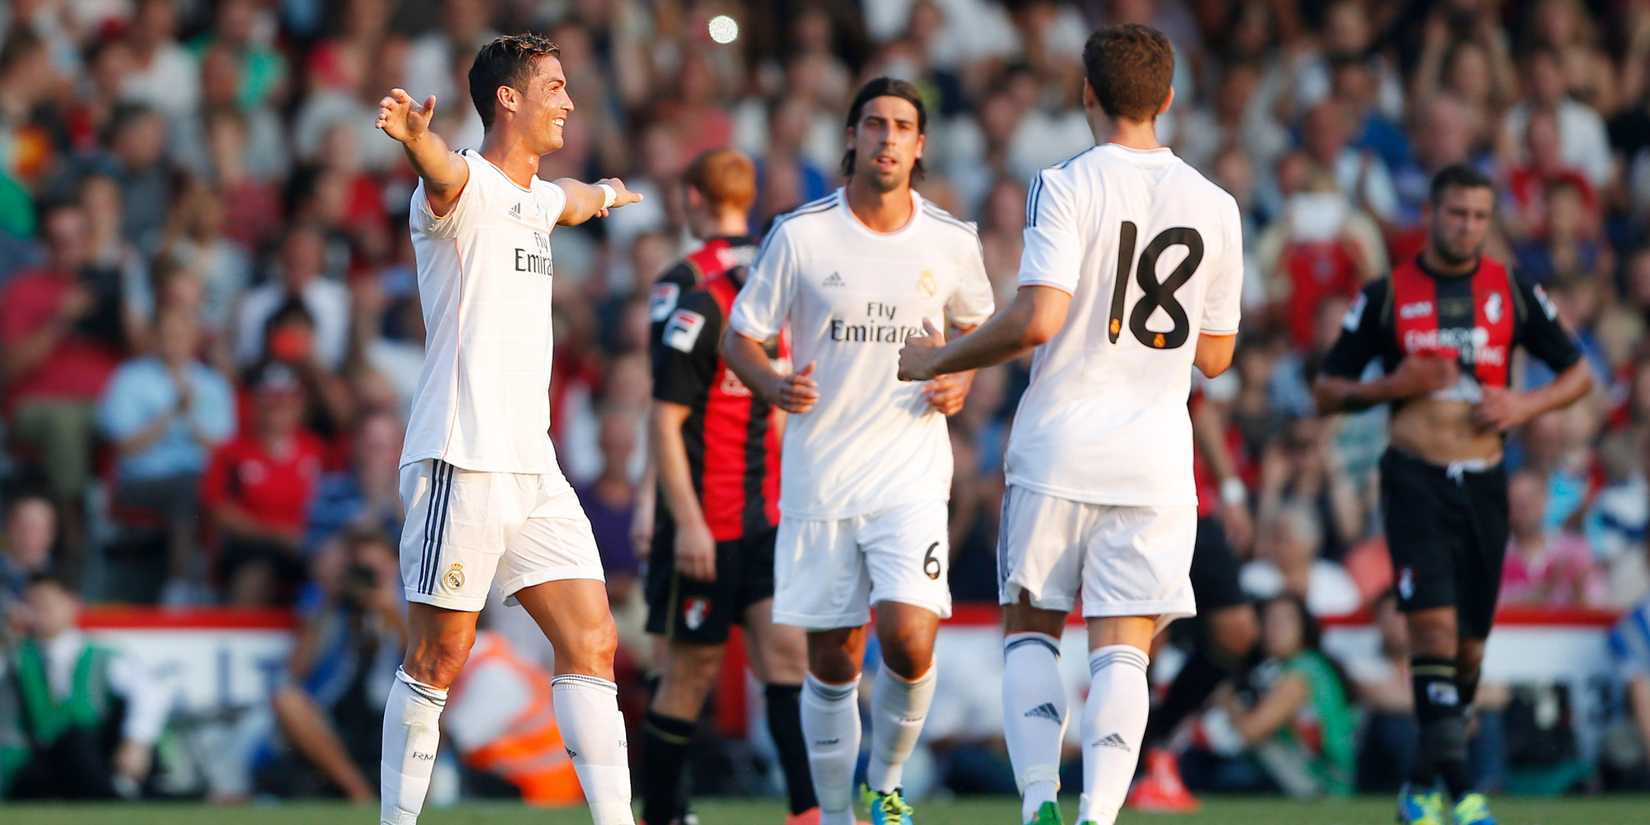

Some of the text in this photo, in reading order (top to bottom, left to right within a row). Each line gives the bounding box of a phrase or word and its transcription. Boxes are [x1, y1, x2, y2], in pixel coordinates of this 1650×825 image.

[1108, 221, 1204, 349] 18
[867, 302, 896, 320] Fly
[923, 541, 940, 580] 6
